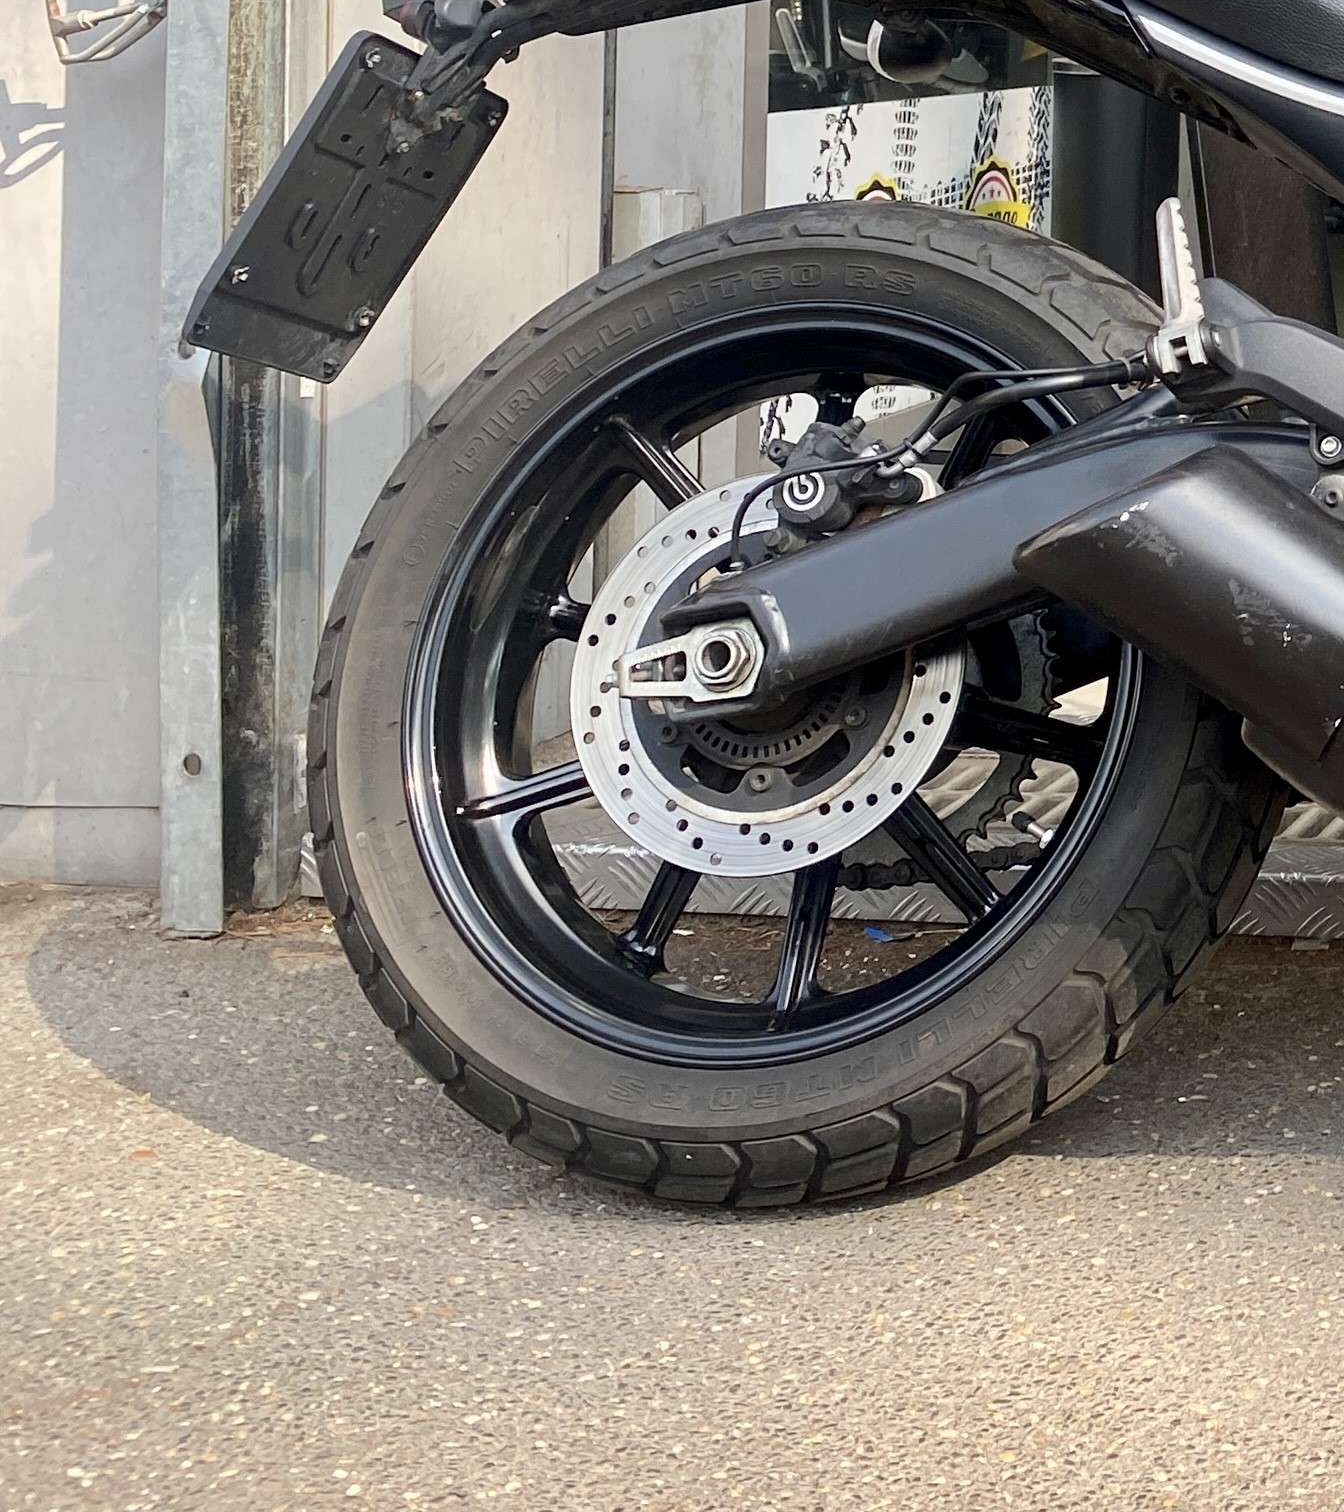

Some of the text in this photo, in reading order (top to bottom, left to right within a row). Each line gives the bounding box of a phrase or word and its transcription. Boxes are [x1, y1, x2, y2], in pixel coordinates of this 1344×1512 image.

[464, 261, 916, 476] PIRELLI MT60 RS
